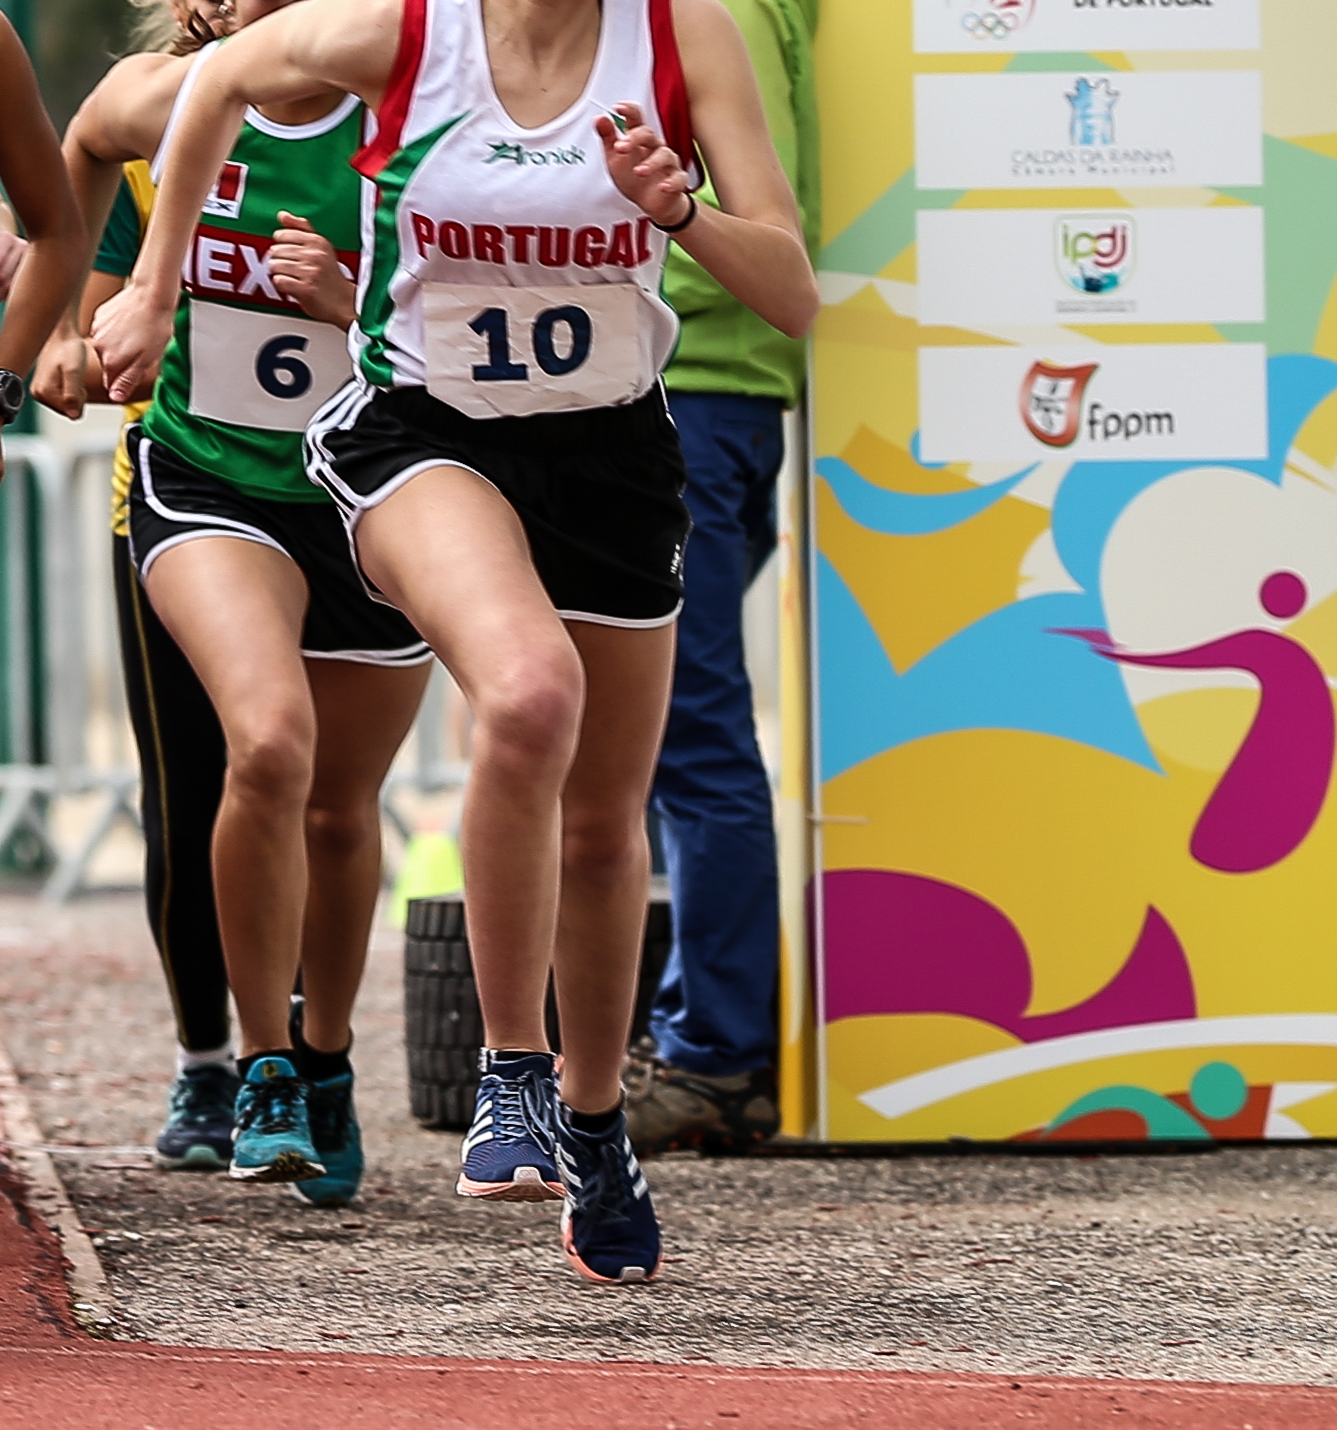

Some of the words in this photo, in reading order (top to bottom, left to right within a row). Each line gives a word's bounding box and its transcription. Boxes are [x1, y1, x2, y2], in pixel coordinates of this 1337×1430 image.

[1012, 148, 1076, 164] CALDAS
[1080, 148, 1104, 164] DA
[1109, 147, 1174, 163] RAINHA
[411, 211, 653, 269] PORTUGAL
[255, 334, 313, 399] 6
[467, 305, 593, 382] 10
[1088, 403, 1175, 441] fppm
